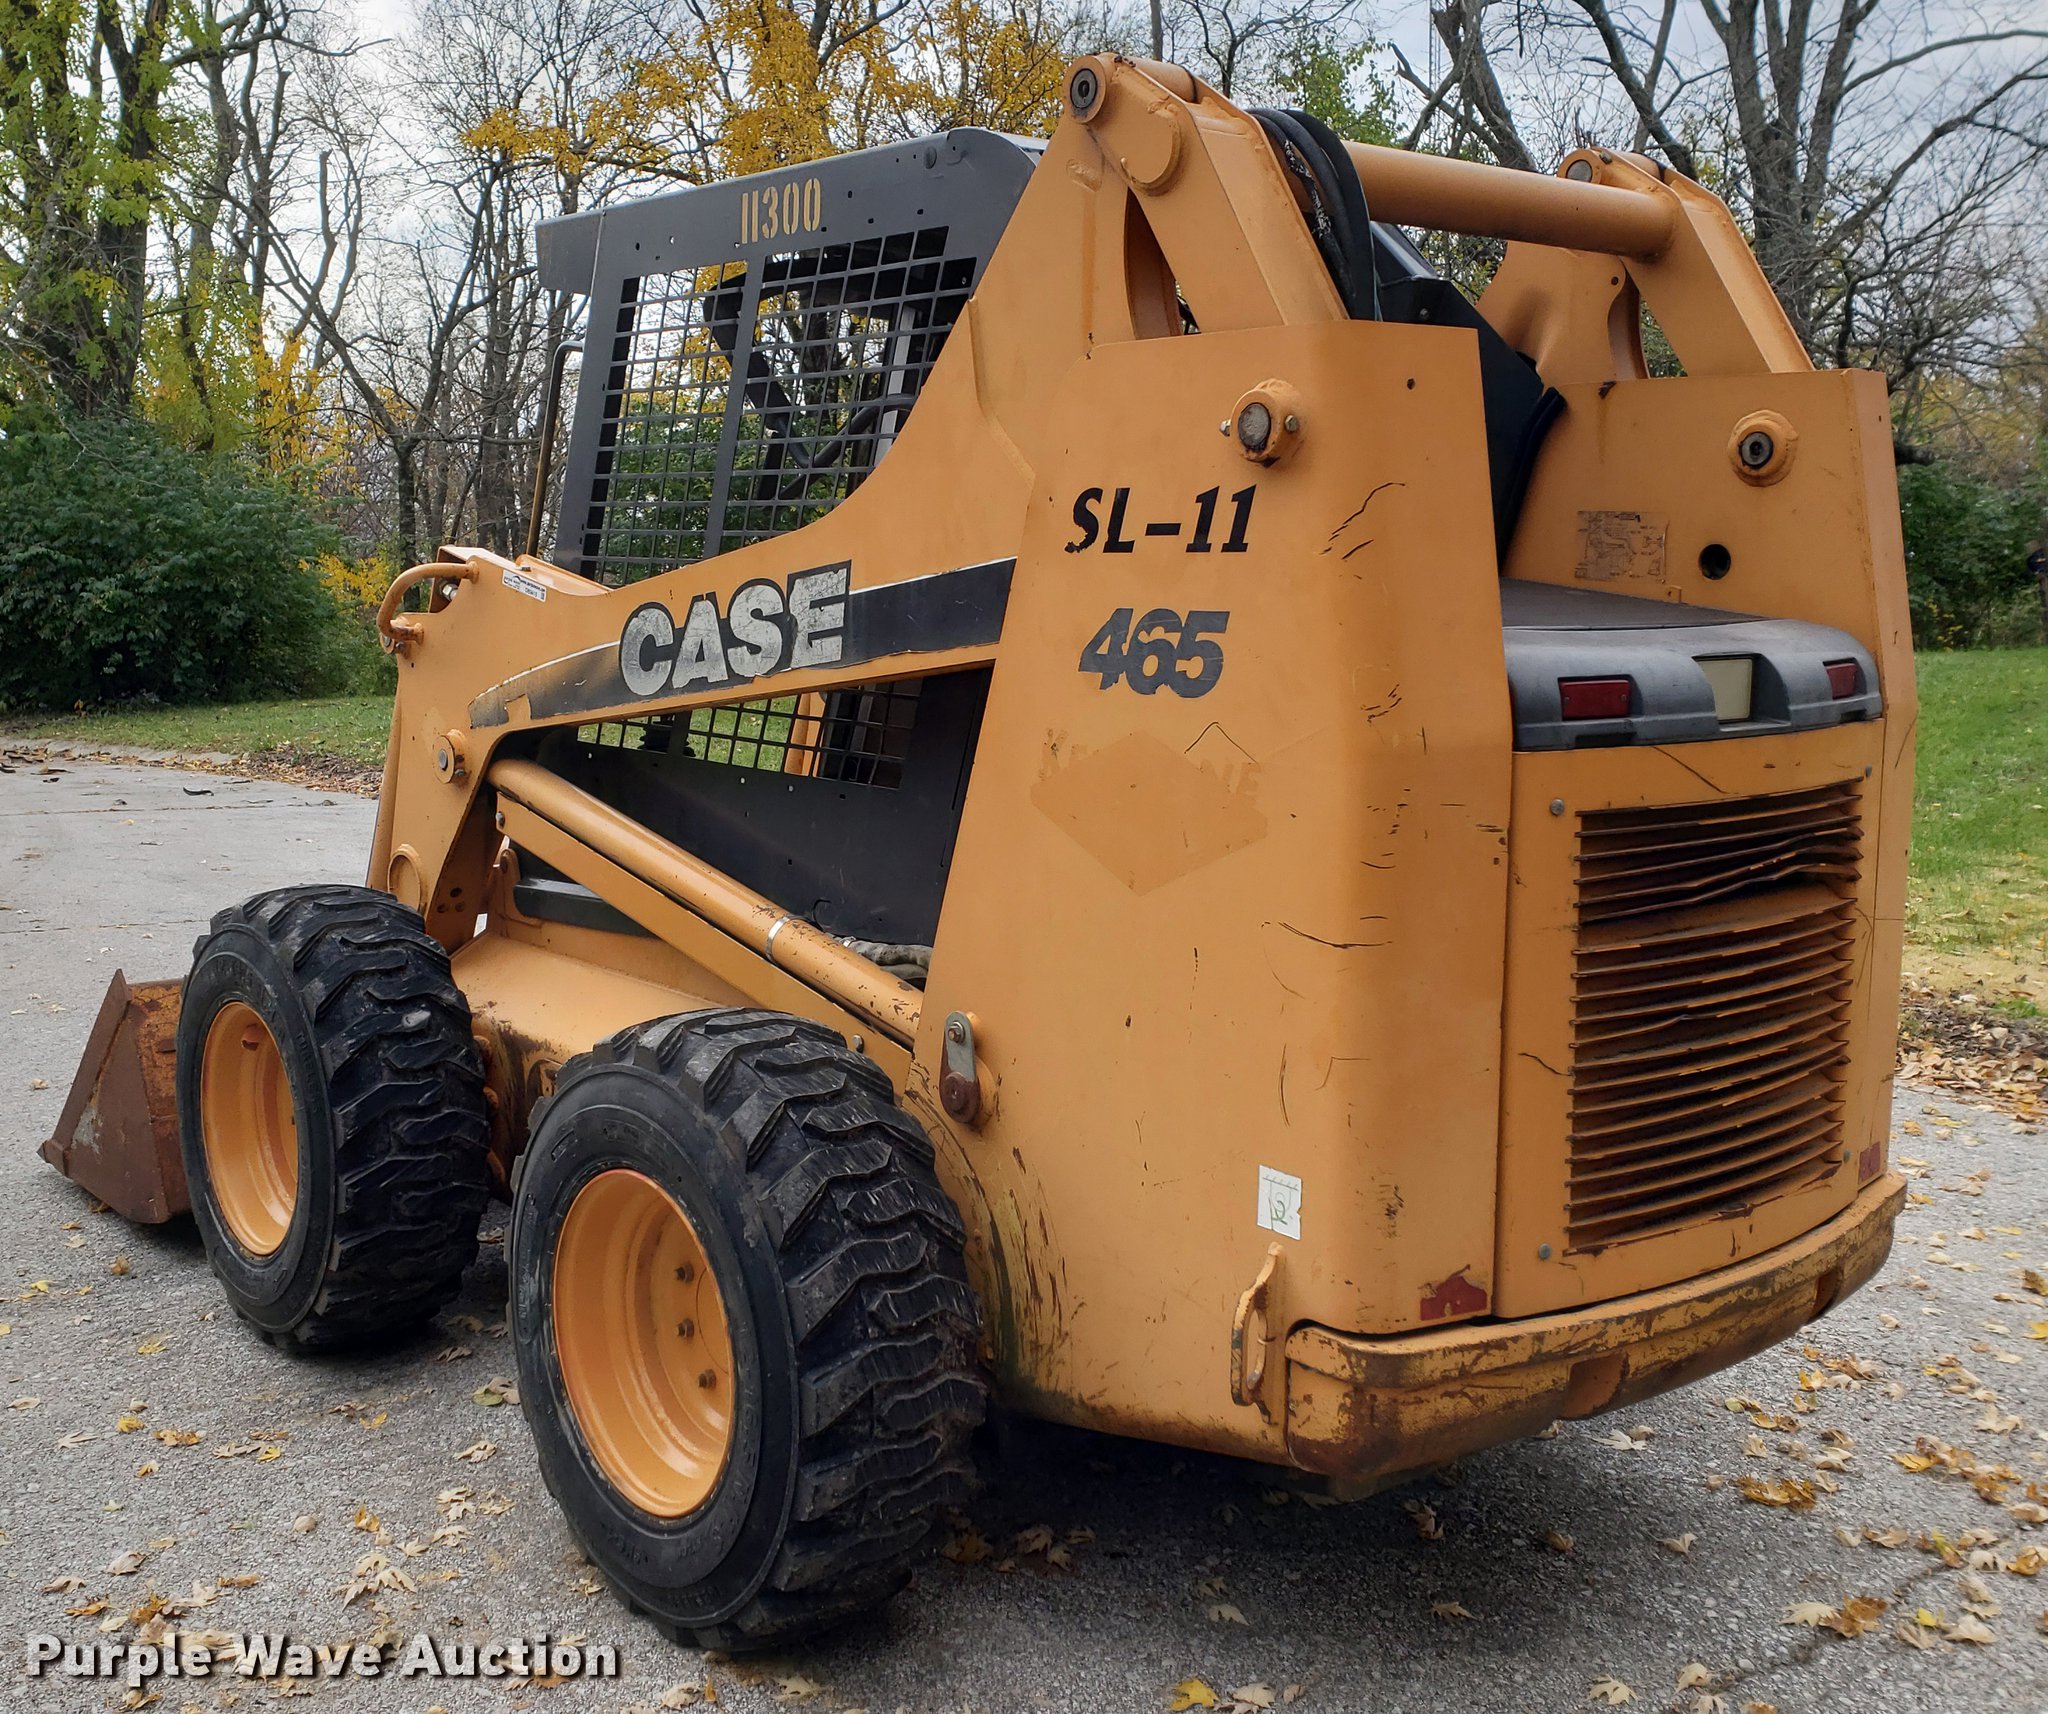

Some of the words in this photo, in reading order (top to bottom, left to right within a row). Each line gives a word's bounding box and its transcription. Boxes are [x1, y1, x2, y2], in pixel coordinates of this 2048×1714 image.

[741, 177, 821, 245] 11300
[1064, 484, 1257, 553] SL-11
[619, 559, 852, 697] CASE
[1078, 608, 1230, 698] 465
